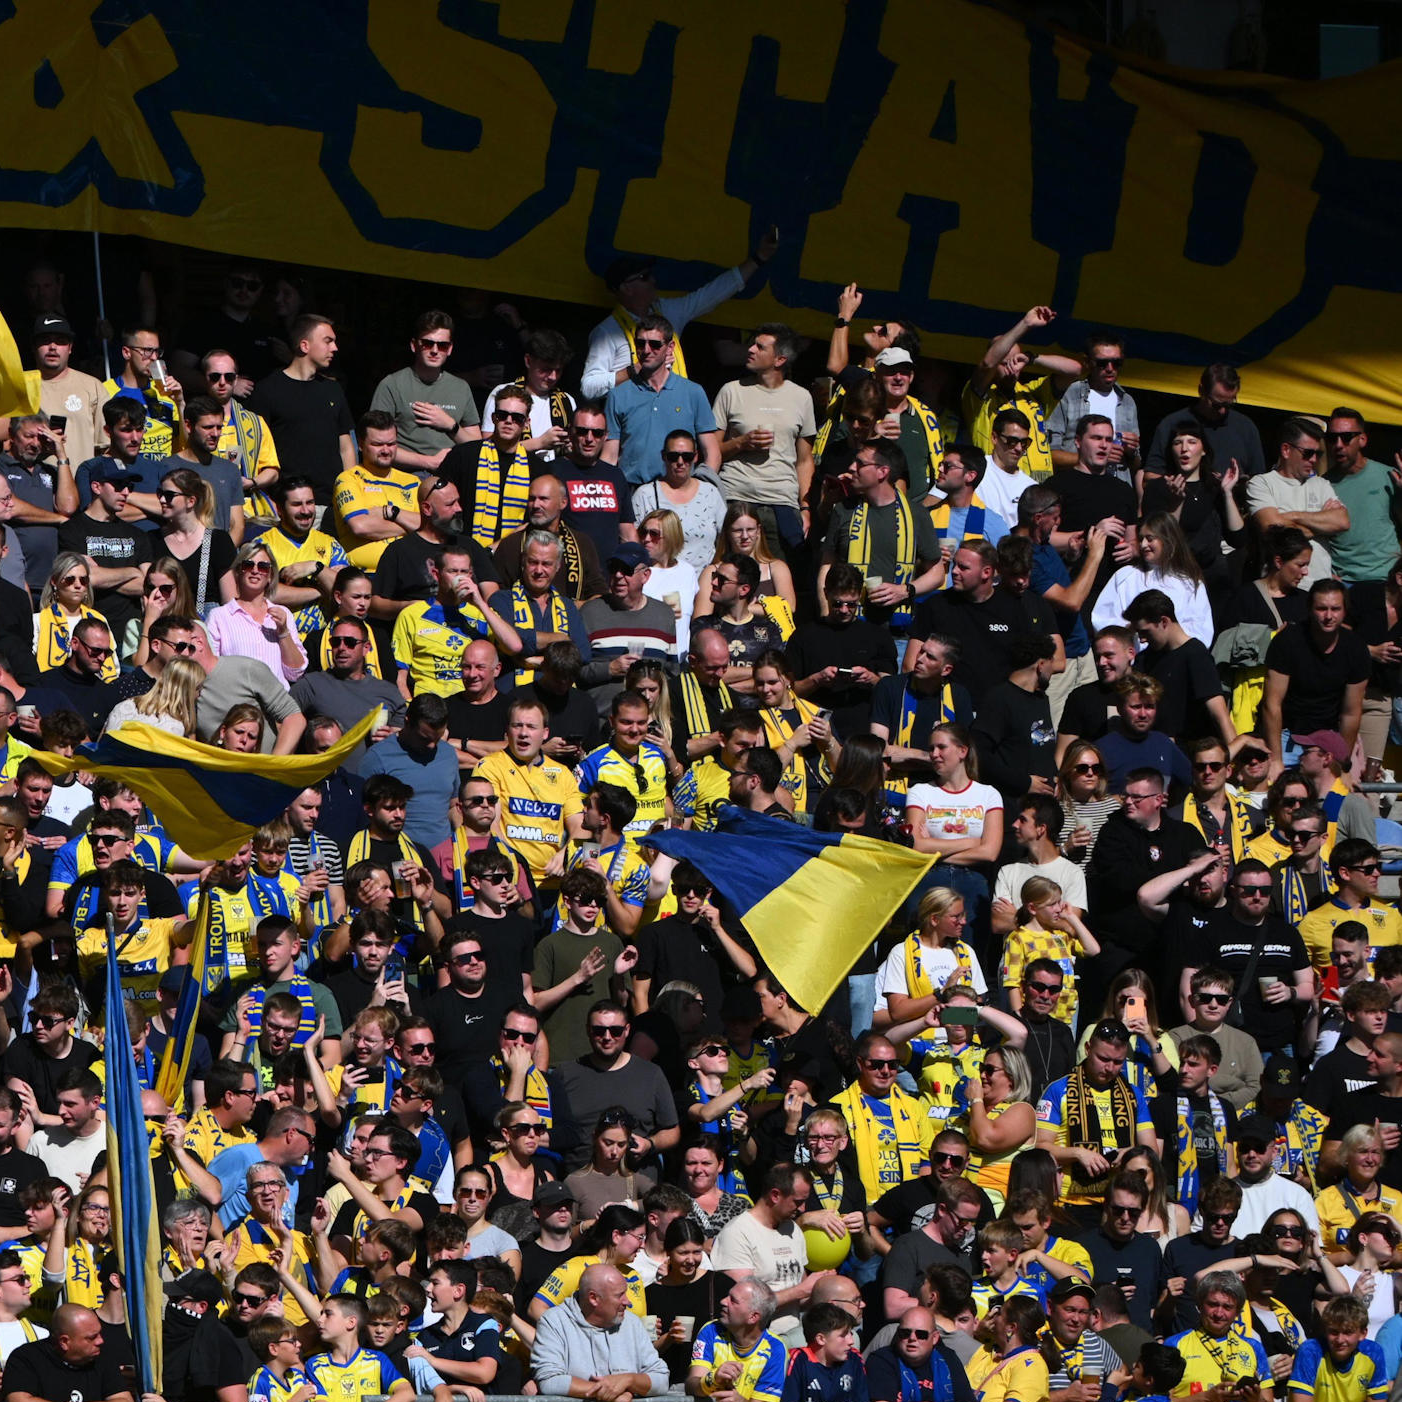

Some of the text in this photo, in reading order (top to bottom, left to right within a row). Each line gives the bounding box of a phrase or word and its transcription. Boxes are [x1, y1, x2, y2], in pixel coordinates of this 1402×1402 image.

[351, 0, 1316, 343] STAD
[570, 483, 613, 495] JACK&
[572, 497, 616, 508] JONES
[987, 623, 1008, 634] 3800
[210, 898, 225, 957] TROUW
